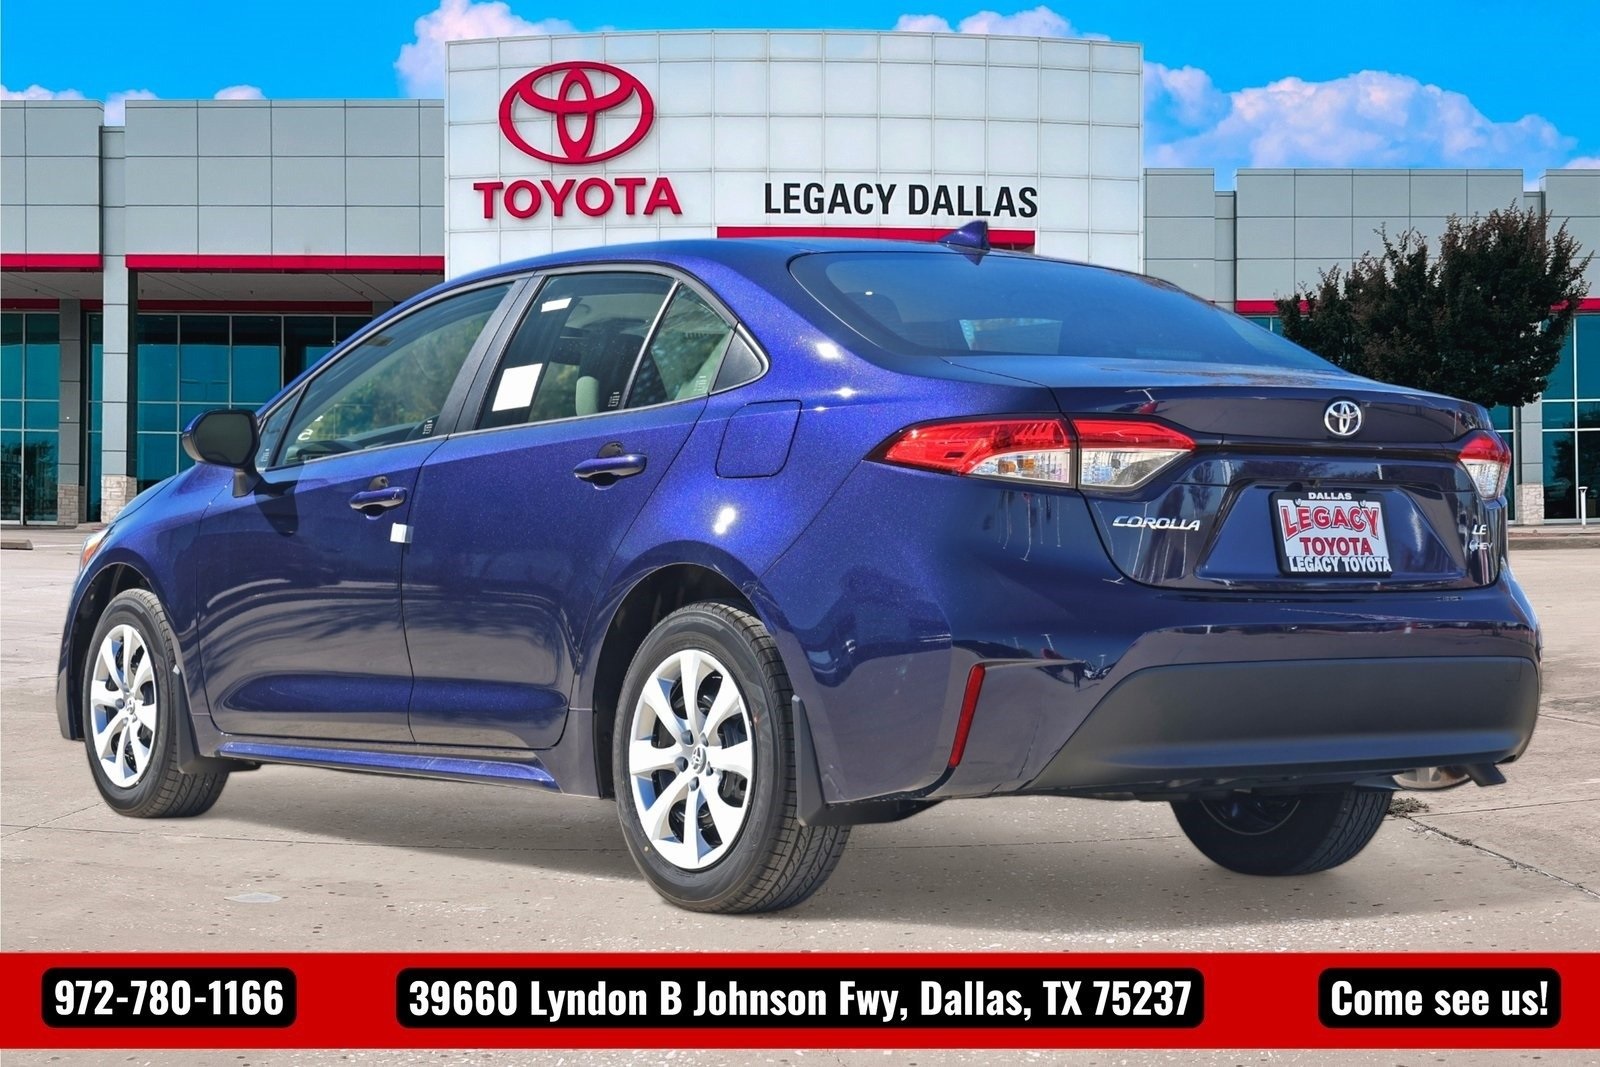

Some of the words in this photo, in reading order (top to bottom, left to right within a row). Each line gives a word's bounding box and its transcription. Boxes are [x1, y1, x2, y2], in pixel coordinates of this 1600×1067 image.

[473, 177, 683, 219] TOYOTA
[764, 182, 897, 215] LEGACY
[908, 184, 1038, 218] DALLAS
[1308, 492, 1352, 500] DALLAS
[1112, 516, 1200, 531] COROLLA
[1280, 505, 1380, 541] LEGACY
[1472, 524, 1487, 535] LE
[1299, 537, 1374, 556] TOYOTA
[1288, 556, 1339, 572] LEGACY
[1341, 556, 1393, 572] TOYOTA
